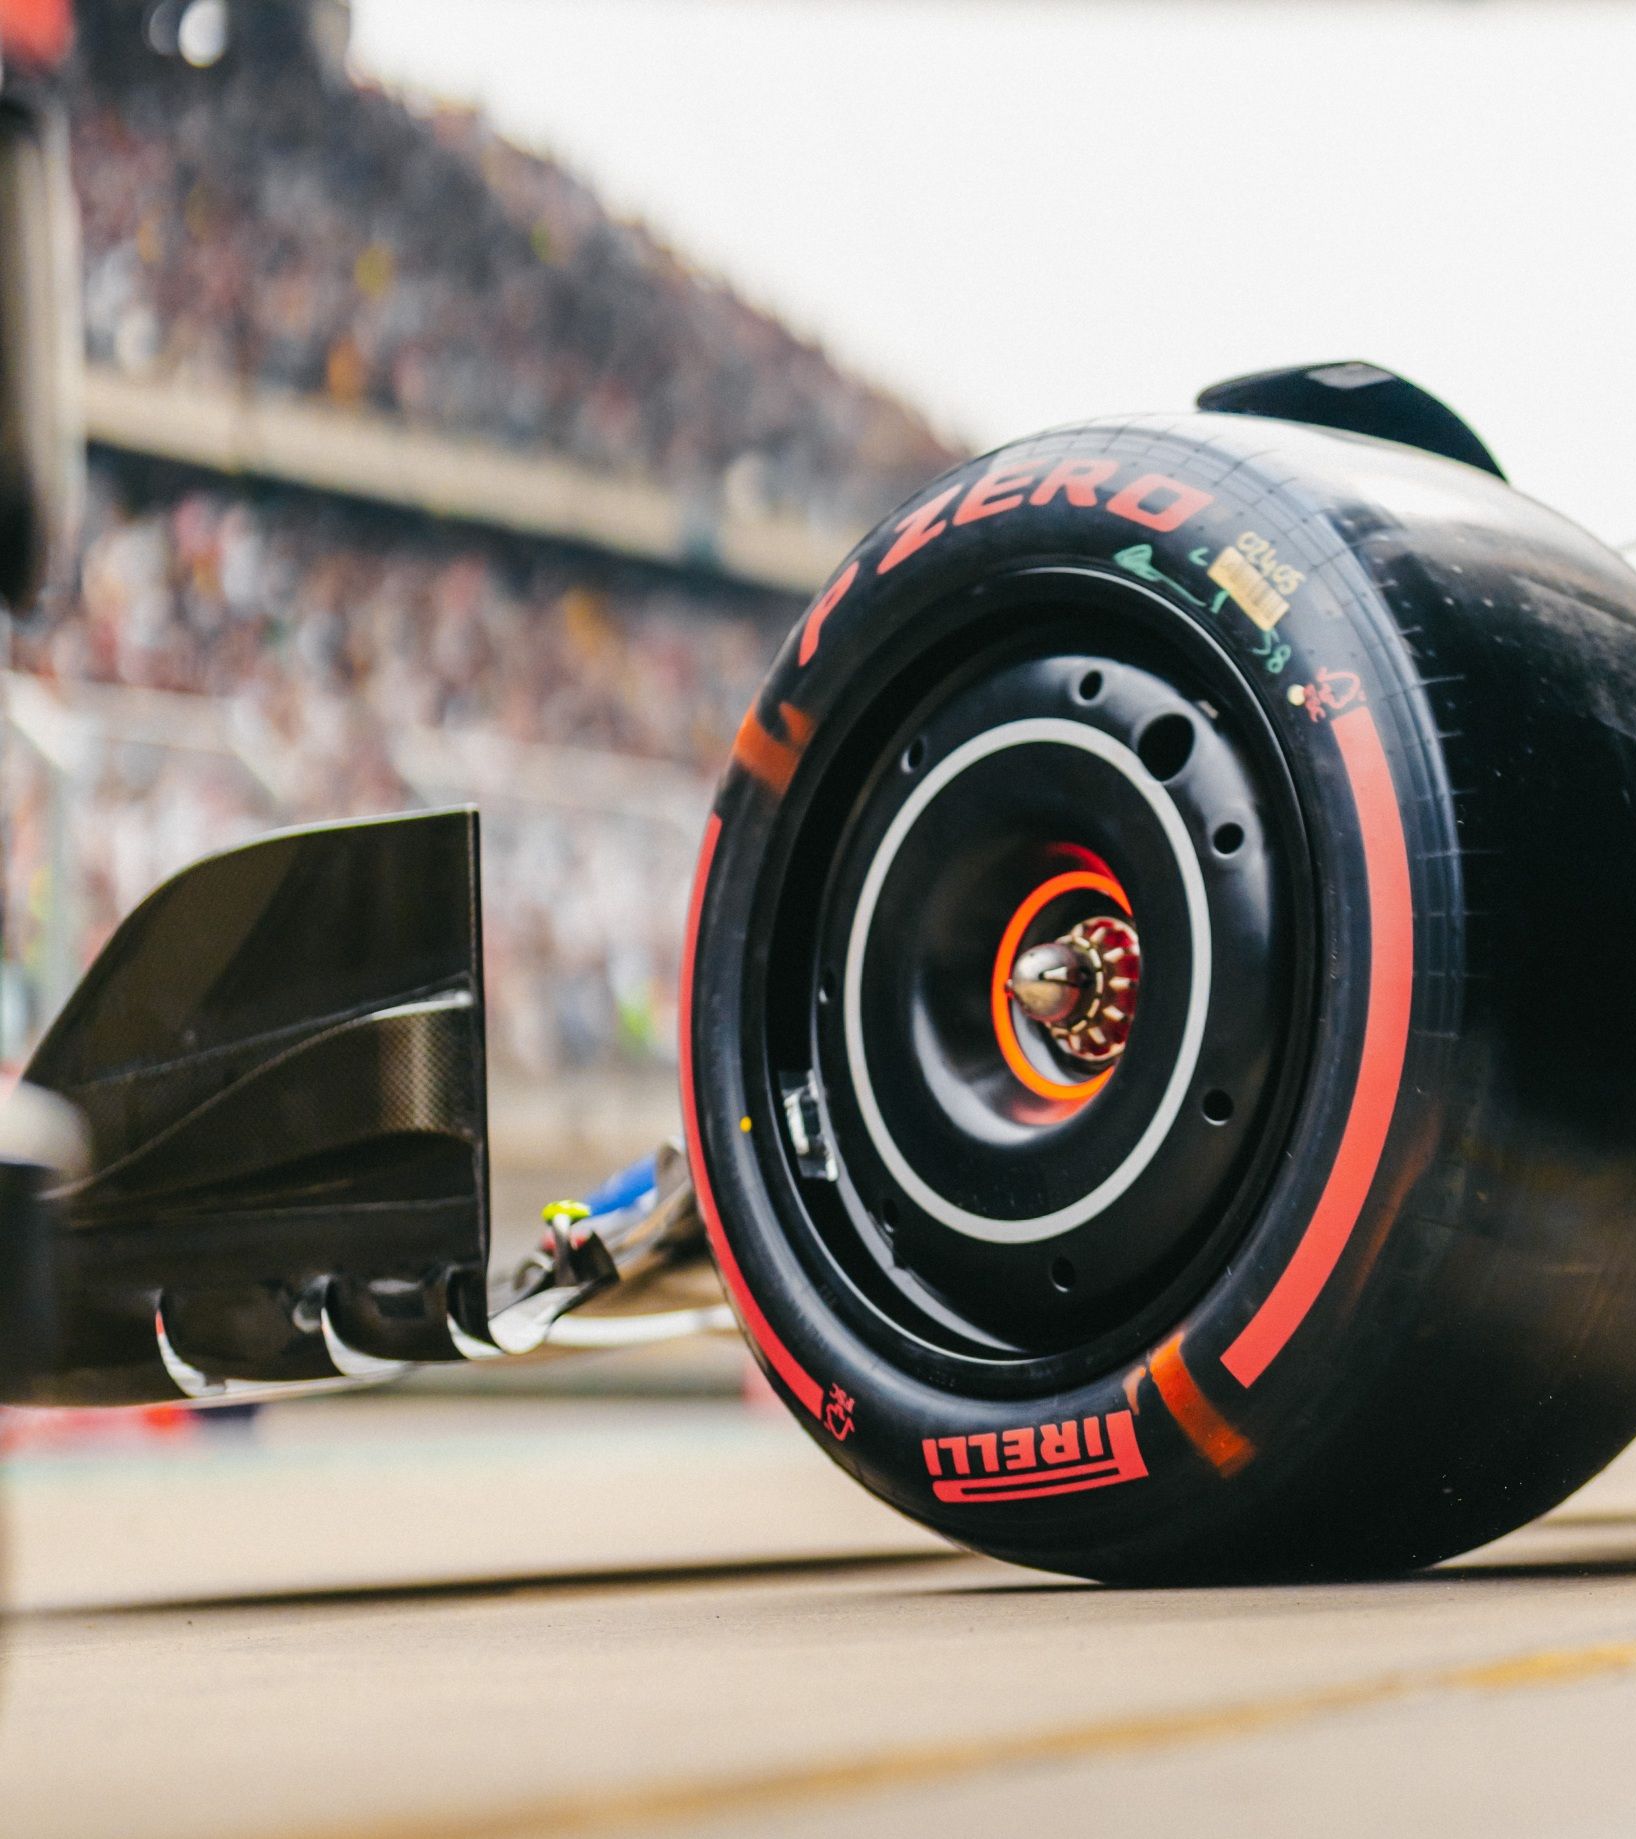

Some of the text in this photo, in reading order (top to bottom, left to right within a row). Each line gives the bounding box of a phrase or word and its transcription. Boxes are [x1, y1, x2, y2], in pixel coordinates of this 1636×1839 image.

[798, 457, 1215, 668] P ZERO
[921, 1408, 1149, 1503] PIRELLI
